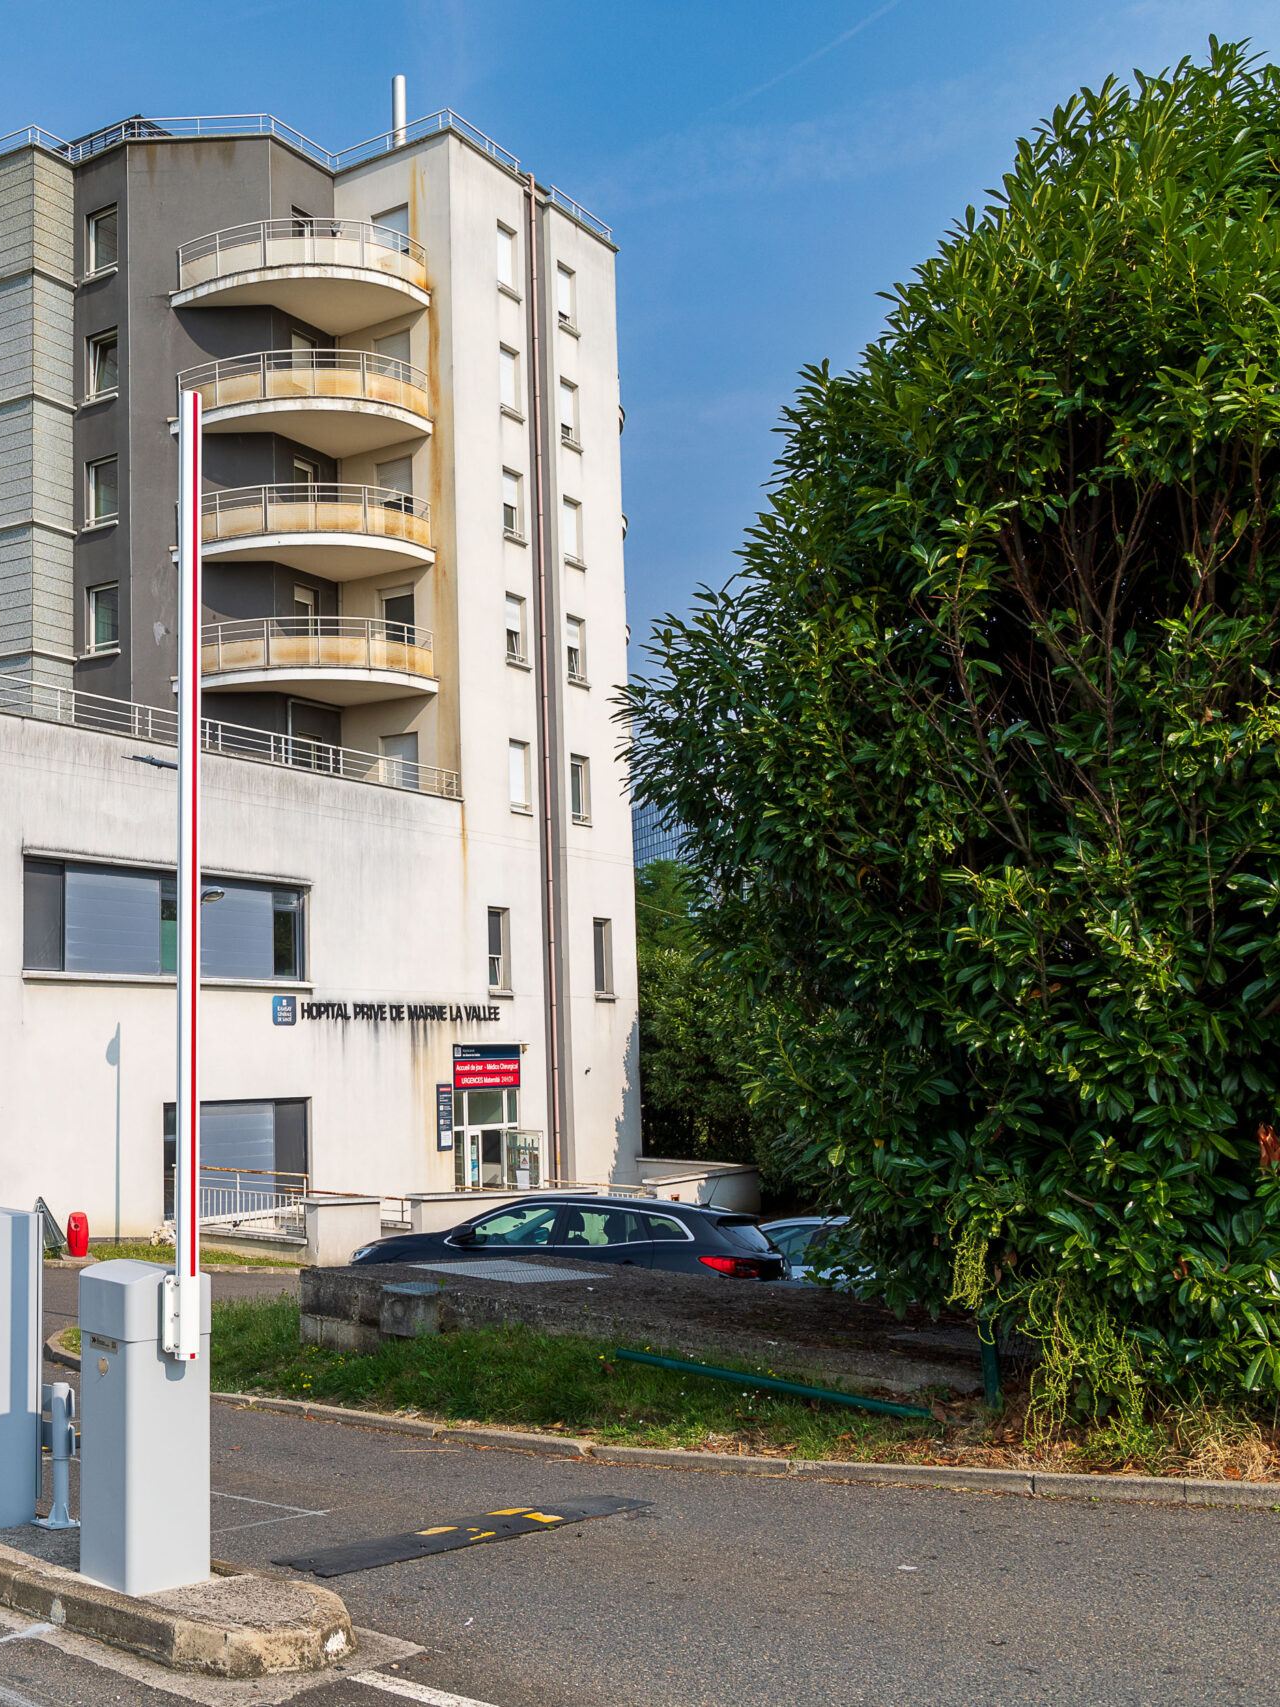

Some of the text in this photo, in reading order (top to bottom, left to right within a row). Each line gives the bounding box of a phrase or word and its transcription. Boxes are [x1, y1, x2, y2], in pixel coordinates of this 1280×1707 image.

[301, 1002, 500, 1021] HOPITAL PRIVE DE MARNE LA VALLEE
[475, 1064, 483, 1072] jour
